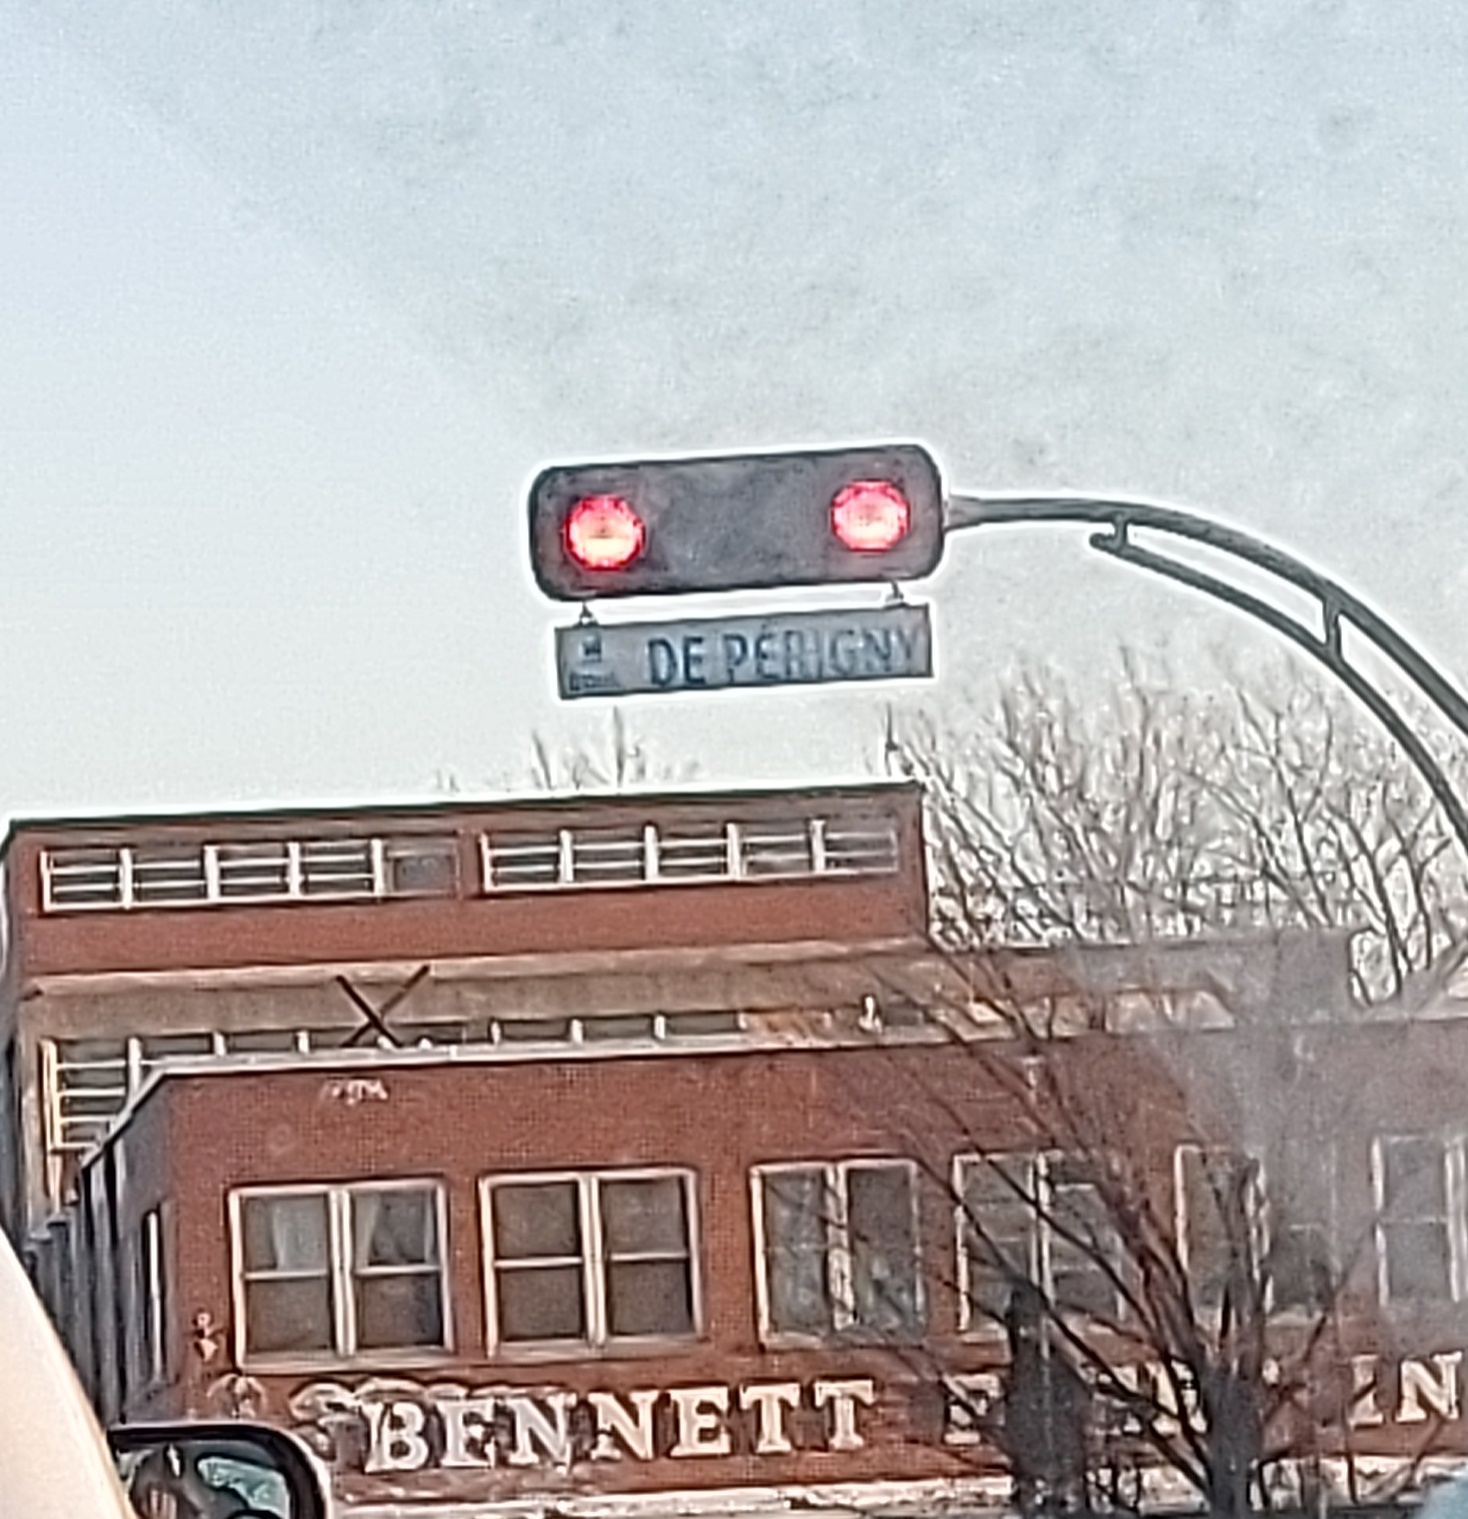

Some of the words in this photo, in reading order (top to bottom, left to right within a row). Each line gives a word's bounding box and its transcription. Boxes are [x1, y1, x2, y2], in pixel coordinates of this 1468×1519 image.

[648, 635, 706, 686] DE
[722, 623, 920, 684] PÉRIGNY
[363, 1378, 873, 1474] BENNETT
